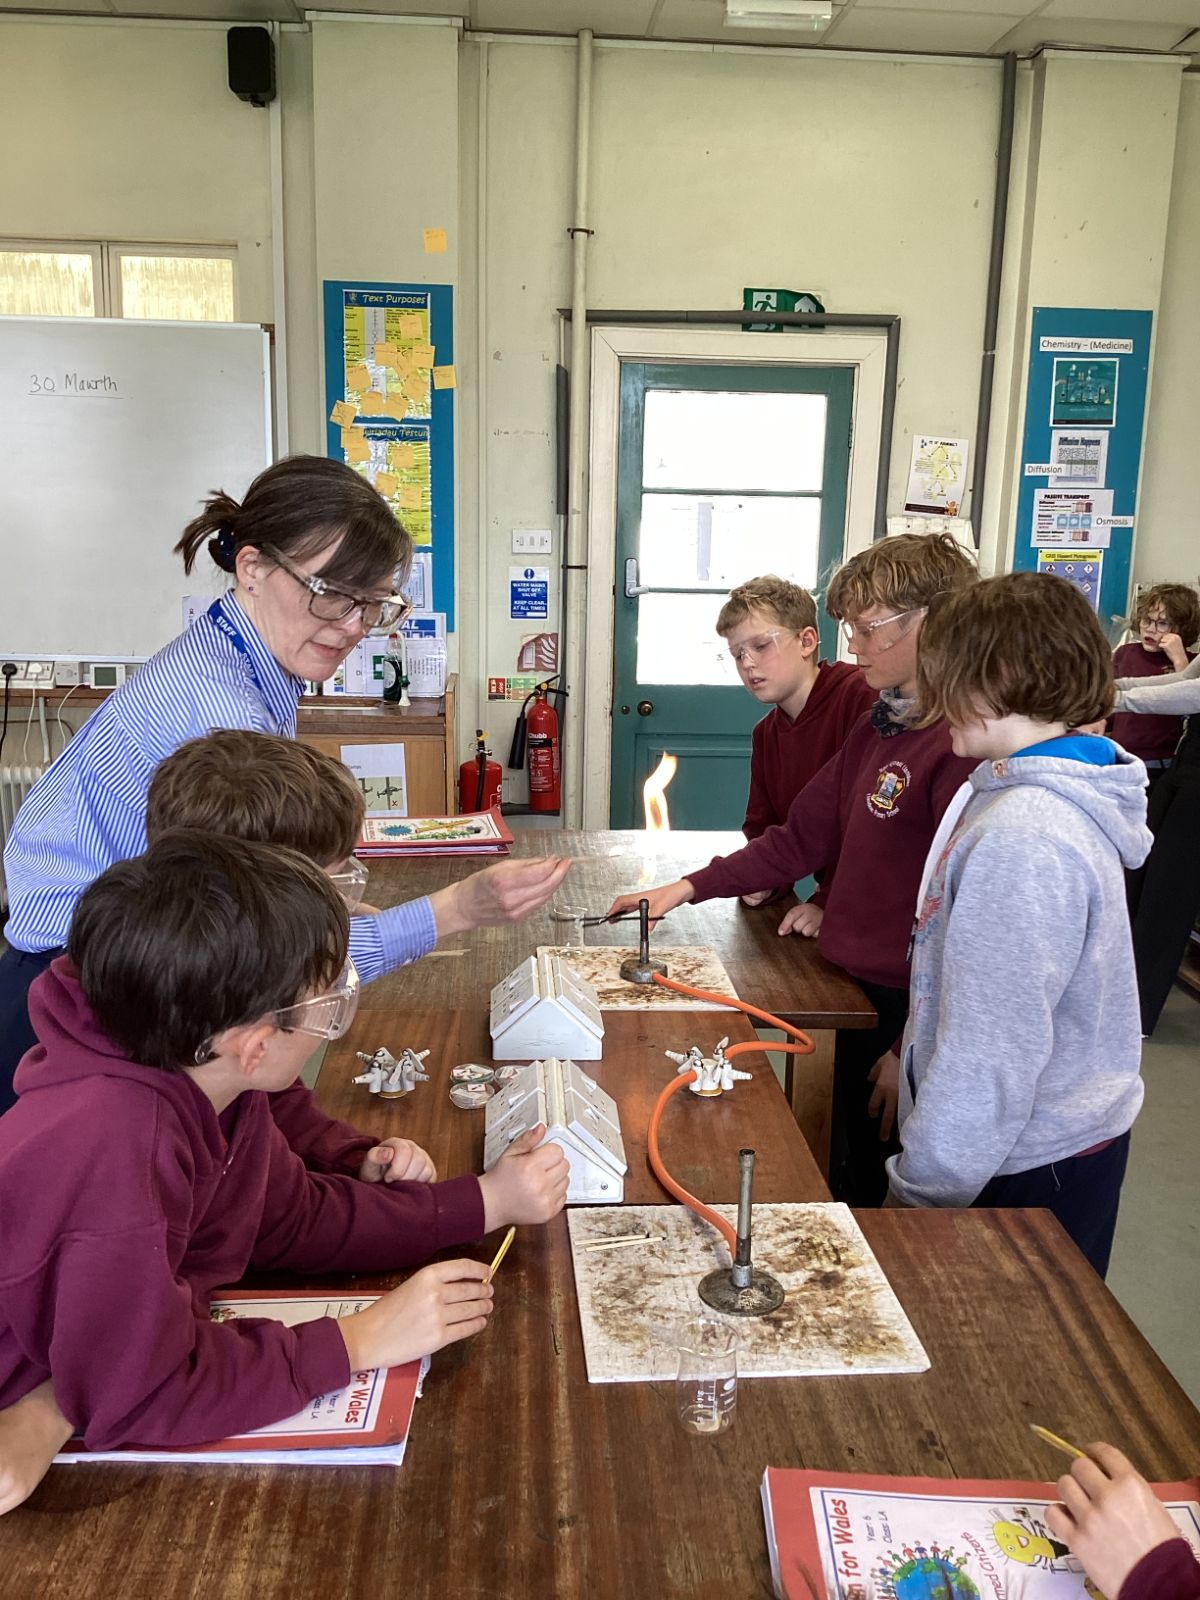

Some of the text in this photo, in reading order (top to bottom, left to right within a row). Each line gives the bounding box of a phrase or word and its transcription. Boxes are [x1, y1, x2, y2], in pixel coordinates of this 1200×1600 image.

[363, 294, 426, 304] Text Purposes
[1041, 340, 1081, 350] Chemistry
[1090, 341, 1132, 350] (Medicine)
[65, 373, 118, 392] Mawrth
[1027, 465, 1062, 474] Diffusion
[1096, 517, 1128, 526] Osmosis
[216, 616, 238, 637] STAFF
[345, 1388, 370, 1424] Wales
[830, 1499, 854, 1545] Wales
[878, 1511, 888, 1521] LA
[960, 1531, 995, 1573] Citizens
[838, 1550, 862, 1577] for
